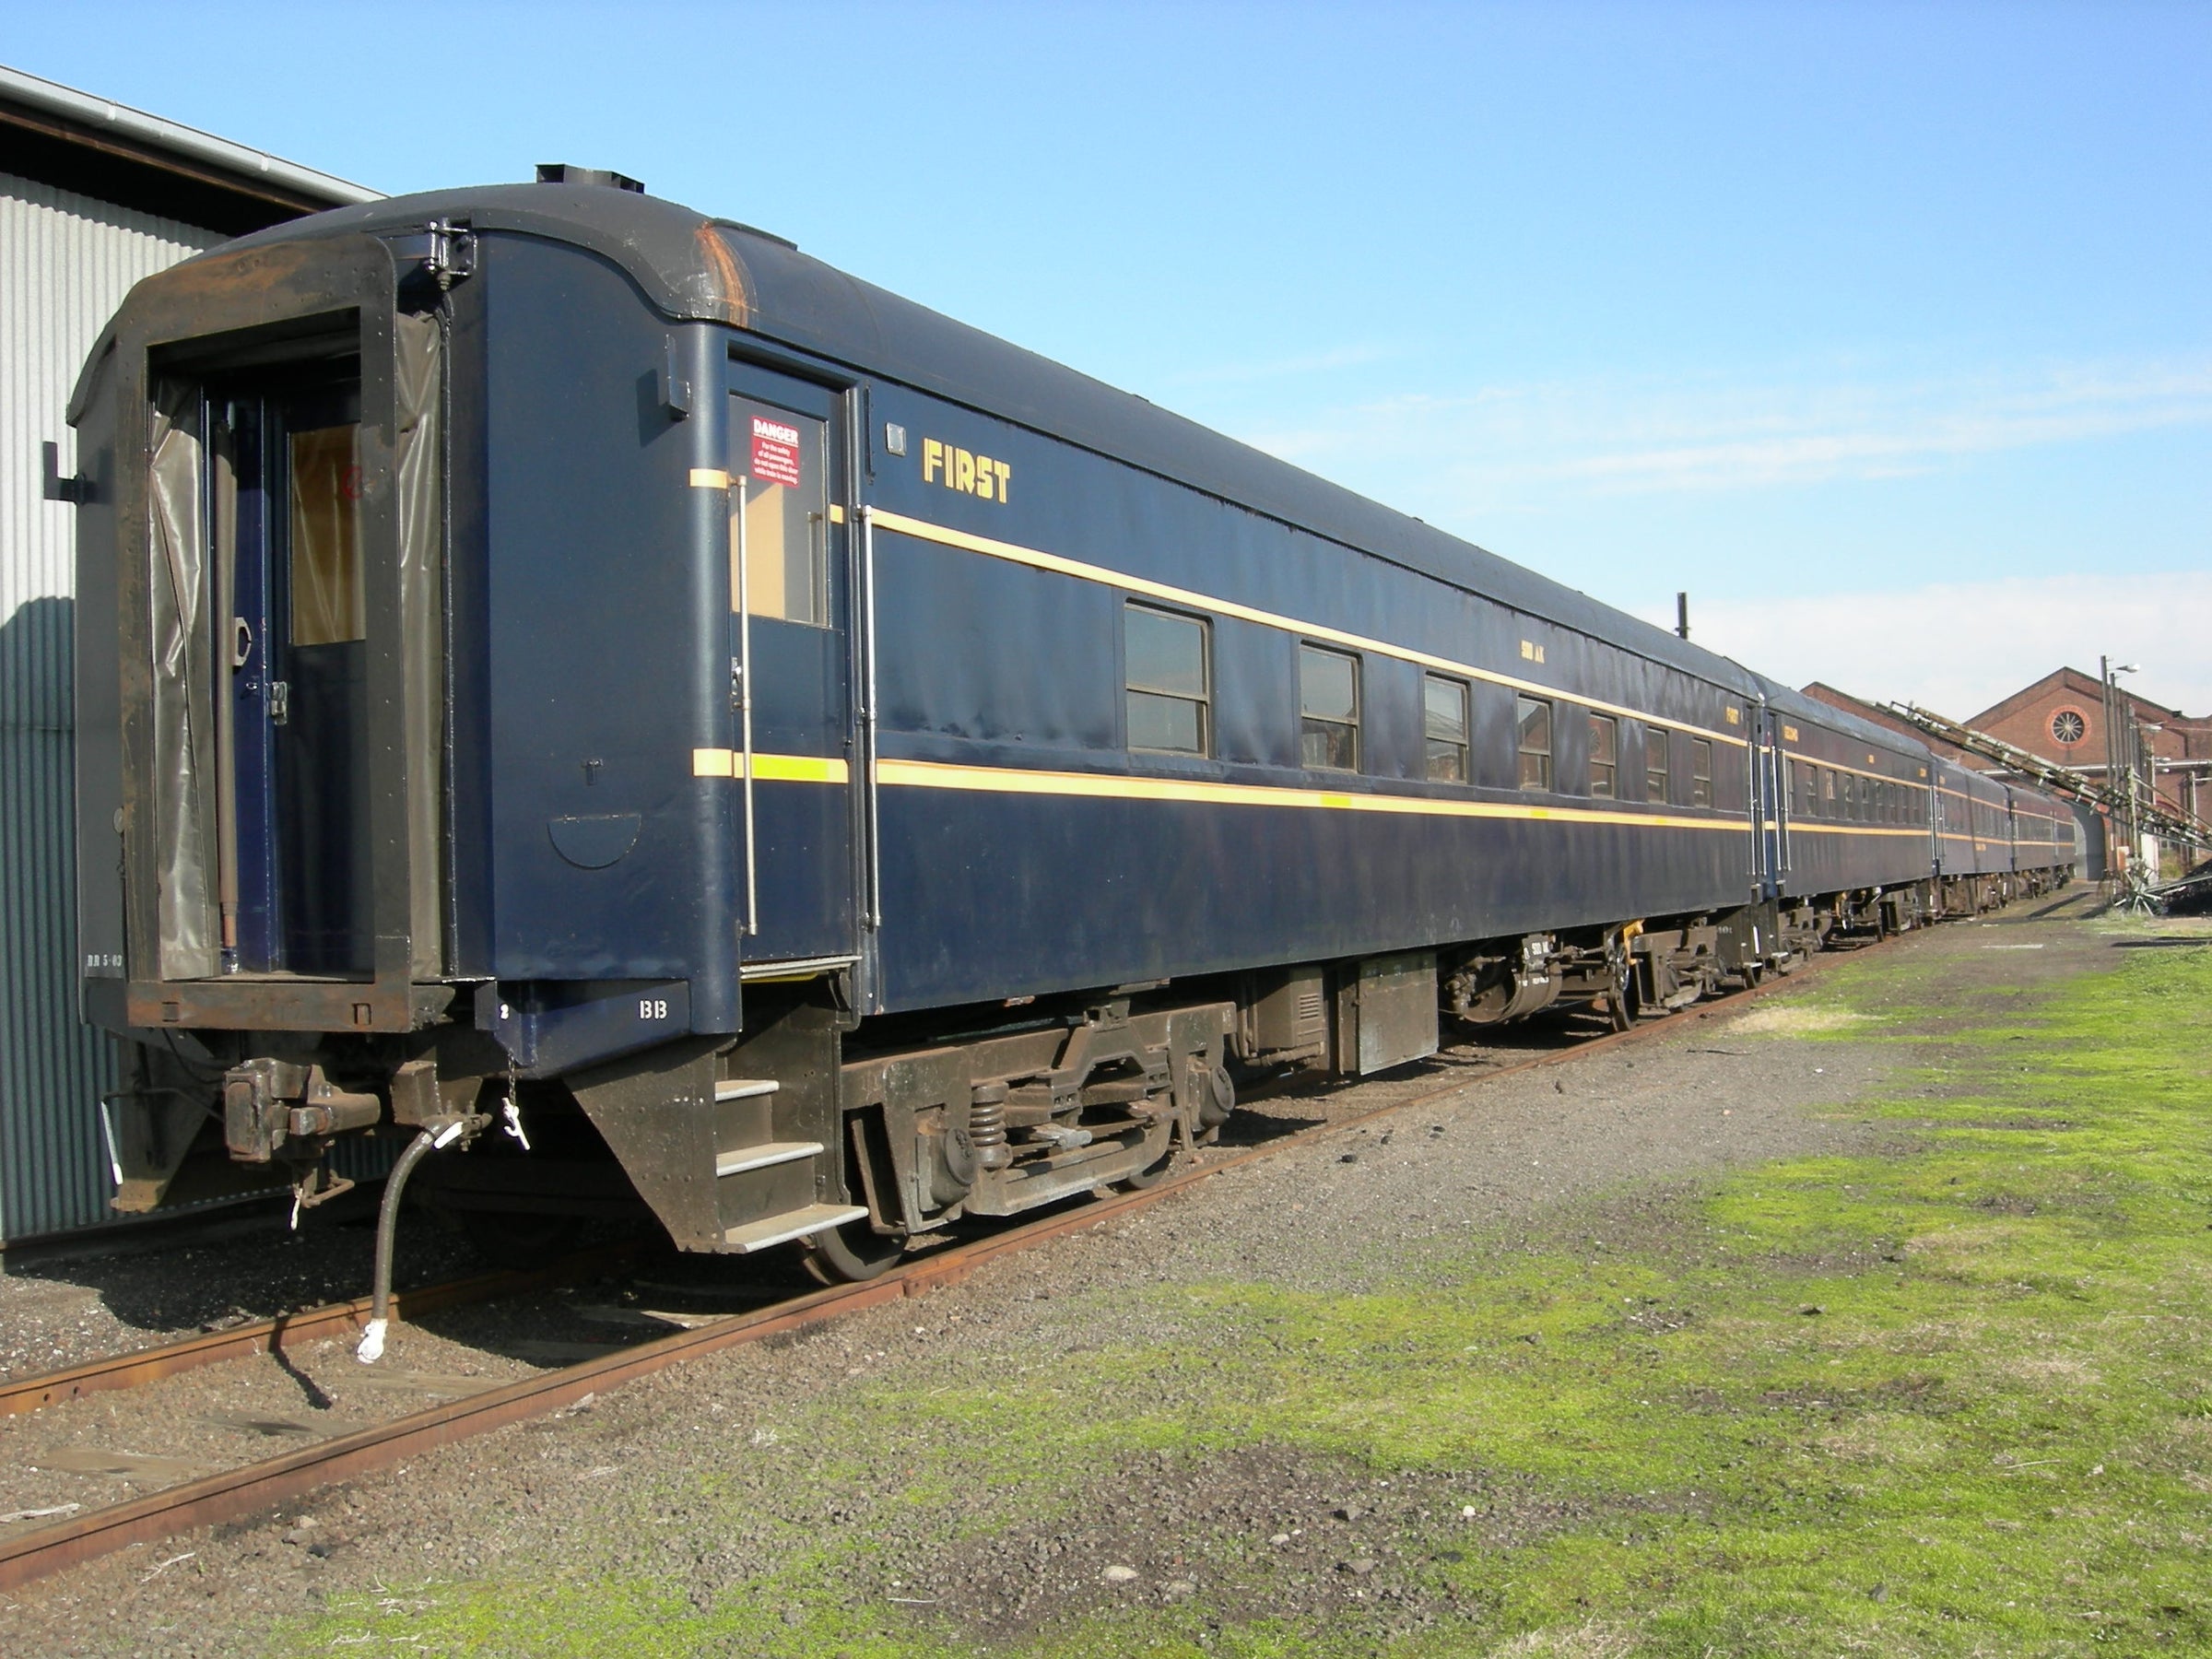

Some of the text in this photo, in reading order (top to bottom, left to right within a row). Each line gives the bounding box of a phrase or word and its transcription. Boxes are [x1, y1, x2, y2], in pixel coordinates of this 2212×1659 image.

[753, 418, 799, 444] DANGER
[924, 437, 1011, 504] FIRST
[640, 999, 667, 1019] BB
